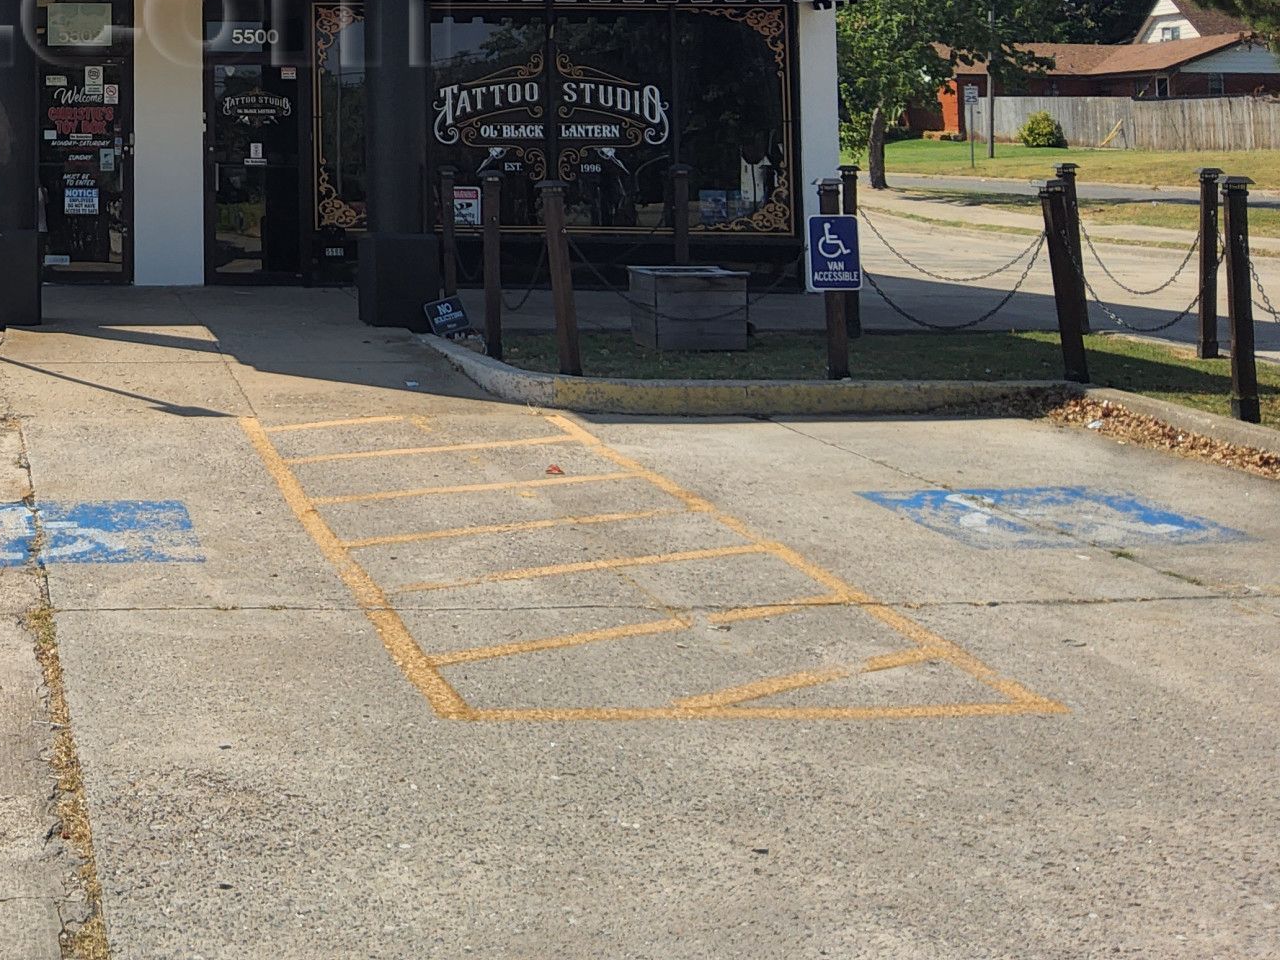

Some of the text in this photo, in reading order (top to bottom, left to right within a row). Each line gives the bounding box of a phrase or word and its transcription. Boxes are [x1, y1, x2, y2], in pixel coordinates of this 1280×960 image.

[232, 28, 279, 45] 5500
[53, 85, 103, 105] Welcome
[433, 82, 669, 144] TATTOO STUDIO
[502, 124, 544, 138] BLACK
[561, 125, 620, 138] LANTERN
[504, 162, 601, 172] EST. 1996
[65, 189, 97, 197] NOTICE
[827, 261, 844, 270] VAN
[814, 271, 859, 281] ACCESSIBLE
[436, 303, 452, 315] NO
